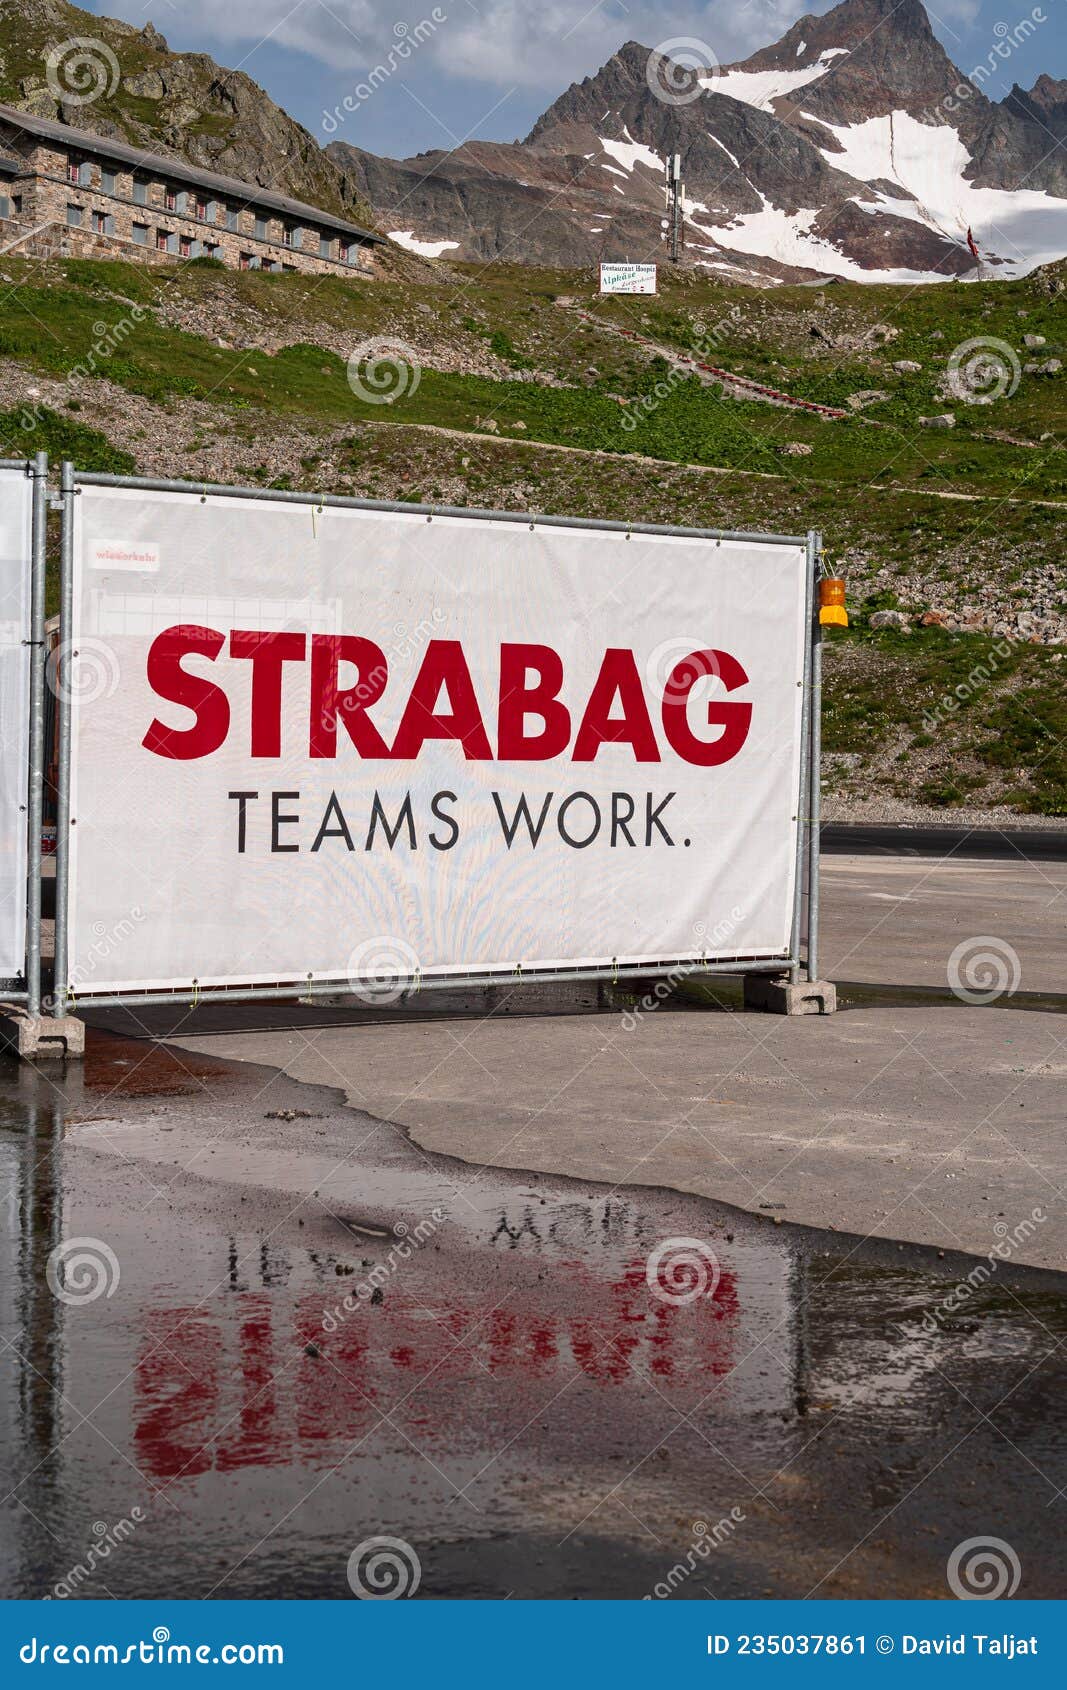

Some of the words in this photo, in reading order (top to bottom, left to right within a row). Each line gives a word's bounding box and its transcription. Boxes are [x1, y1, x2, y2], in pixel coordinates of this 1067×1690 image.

[142, 625, 752, 766] STRABAG
[229, 791, 458, 852] TEAMS
[492, 792, 691, 849] WORK.
